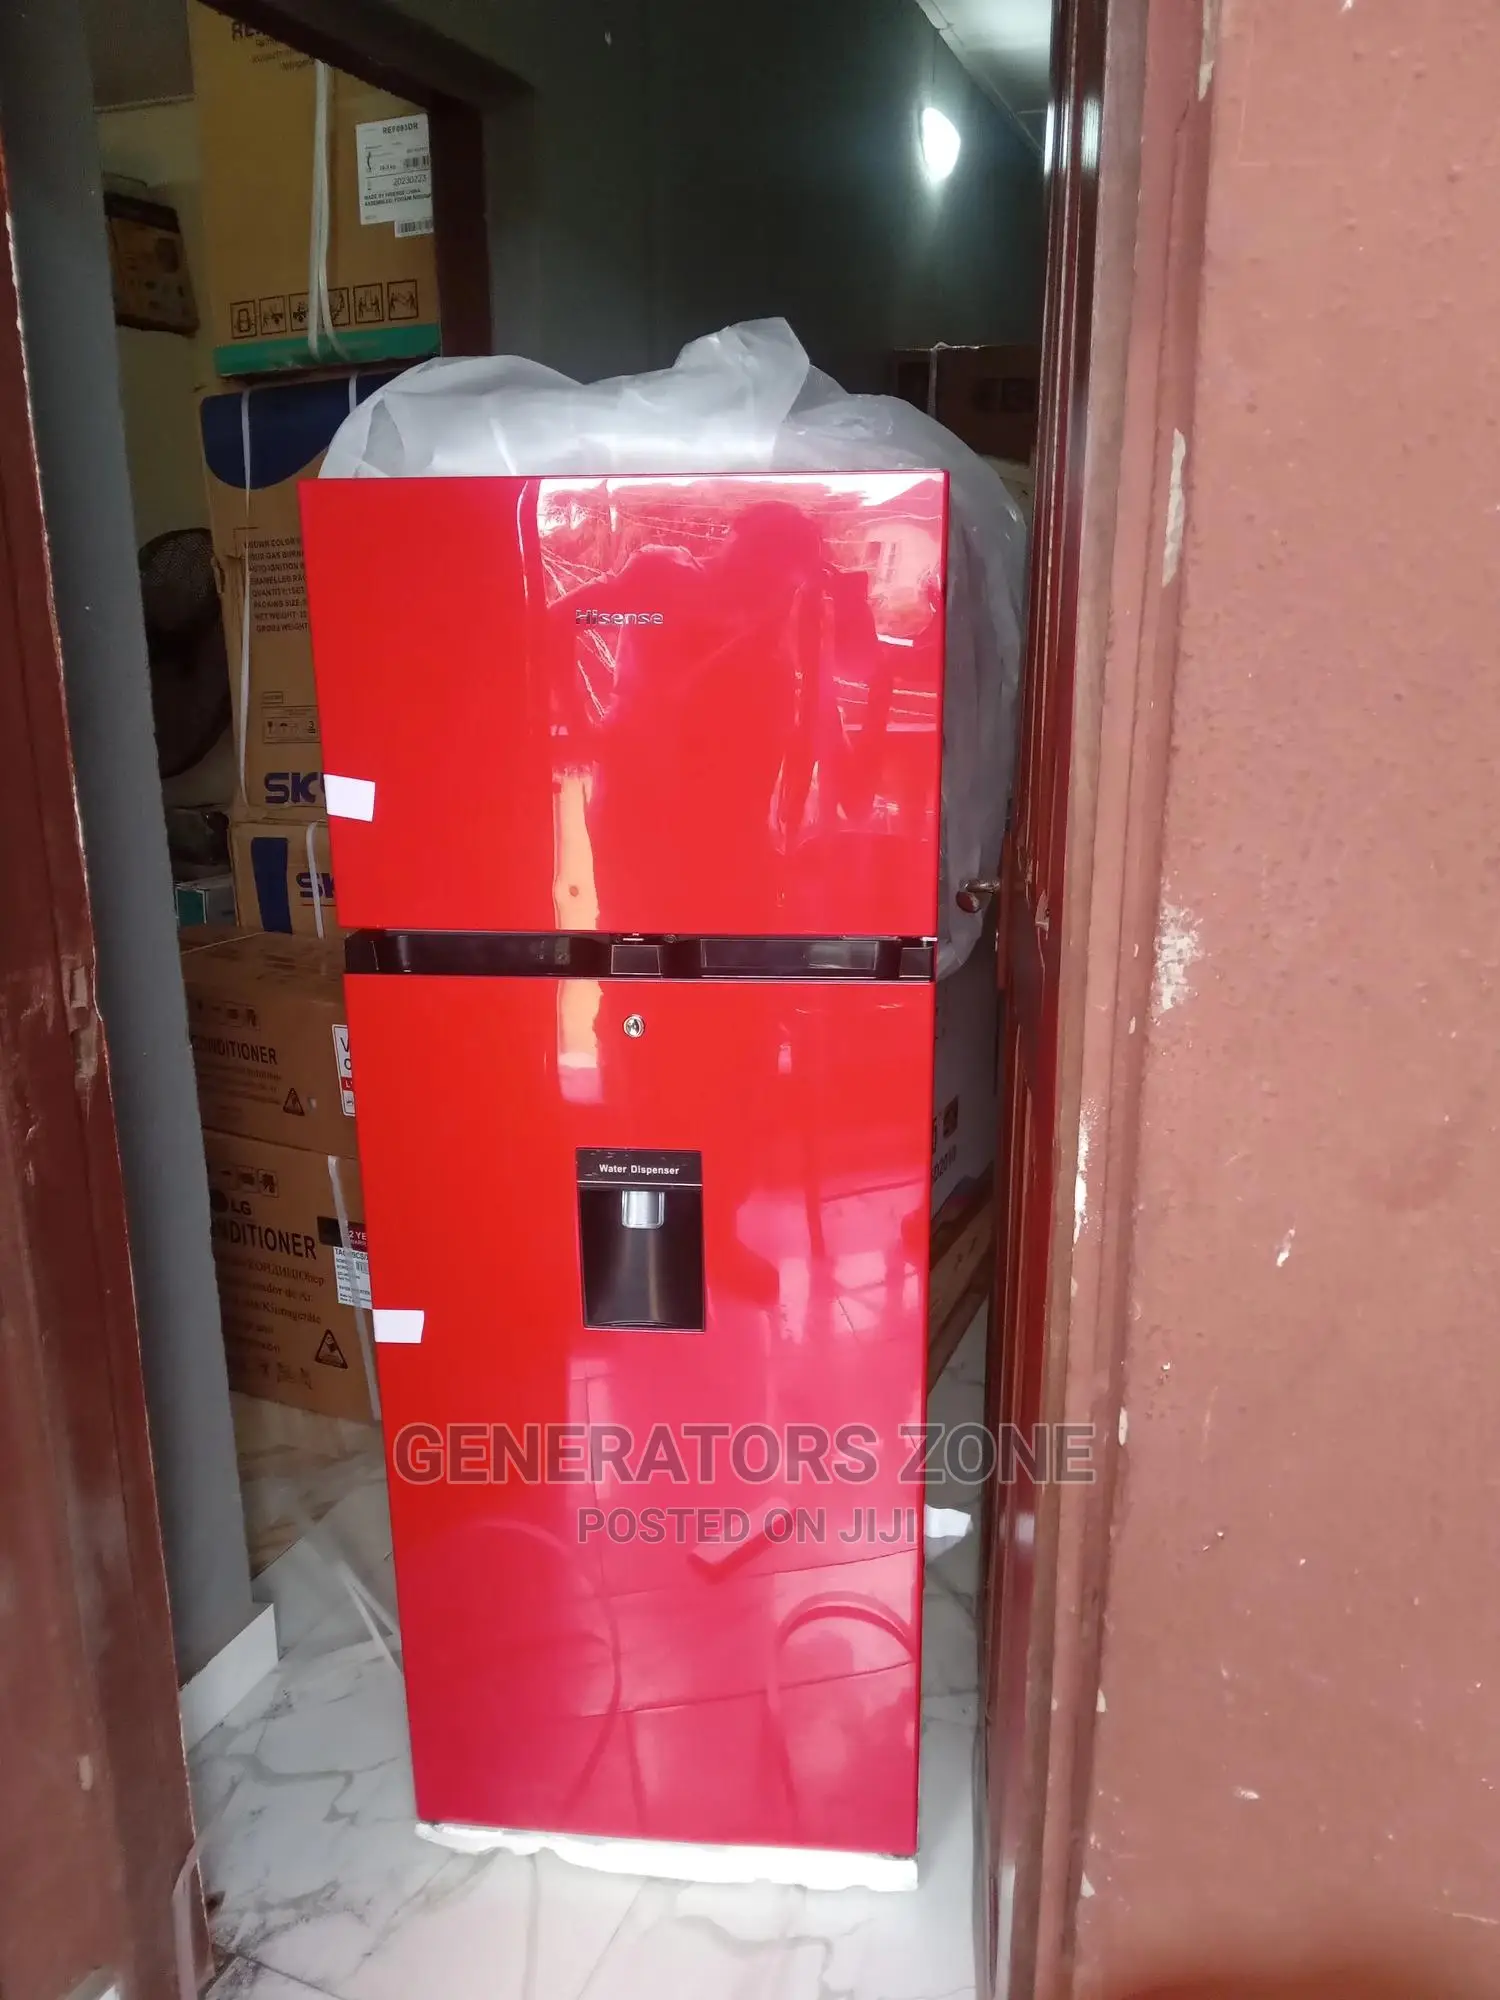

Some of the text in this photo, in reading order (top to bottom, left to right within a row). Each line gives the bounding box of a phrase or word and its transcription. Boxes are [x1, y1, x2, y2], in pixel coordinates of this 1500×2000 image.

[575, 608, 664, 624] Hisense
[599, 1164, 680, 1176] Water Dispenser
[231, 1200, 252, 1216] LG
[348, 1230, 354, 1239] 2
